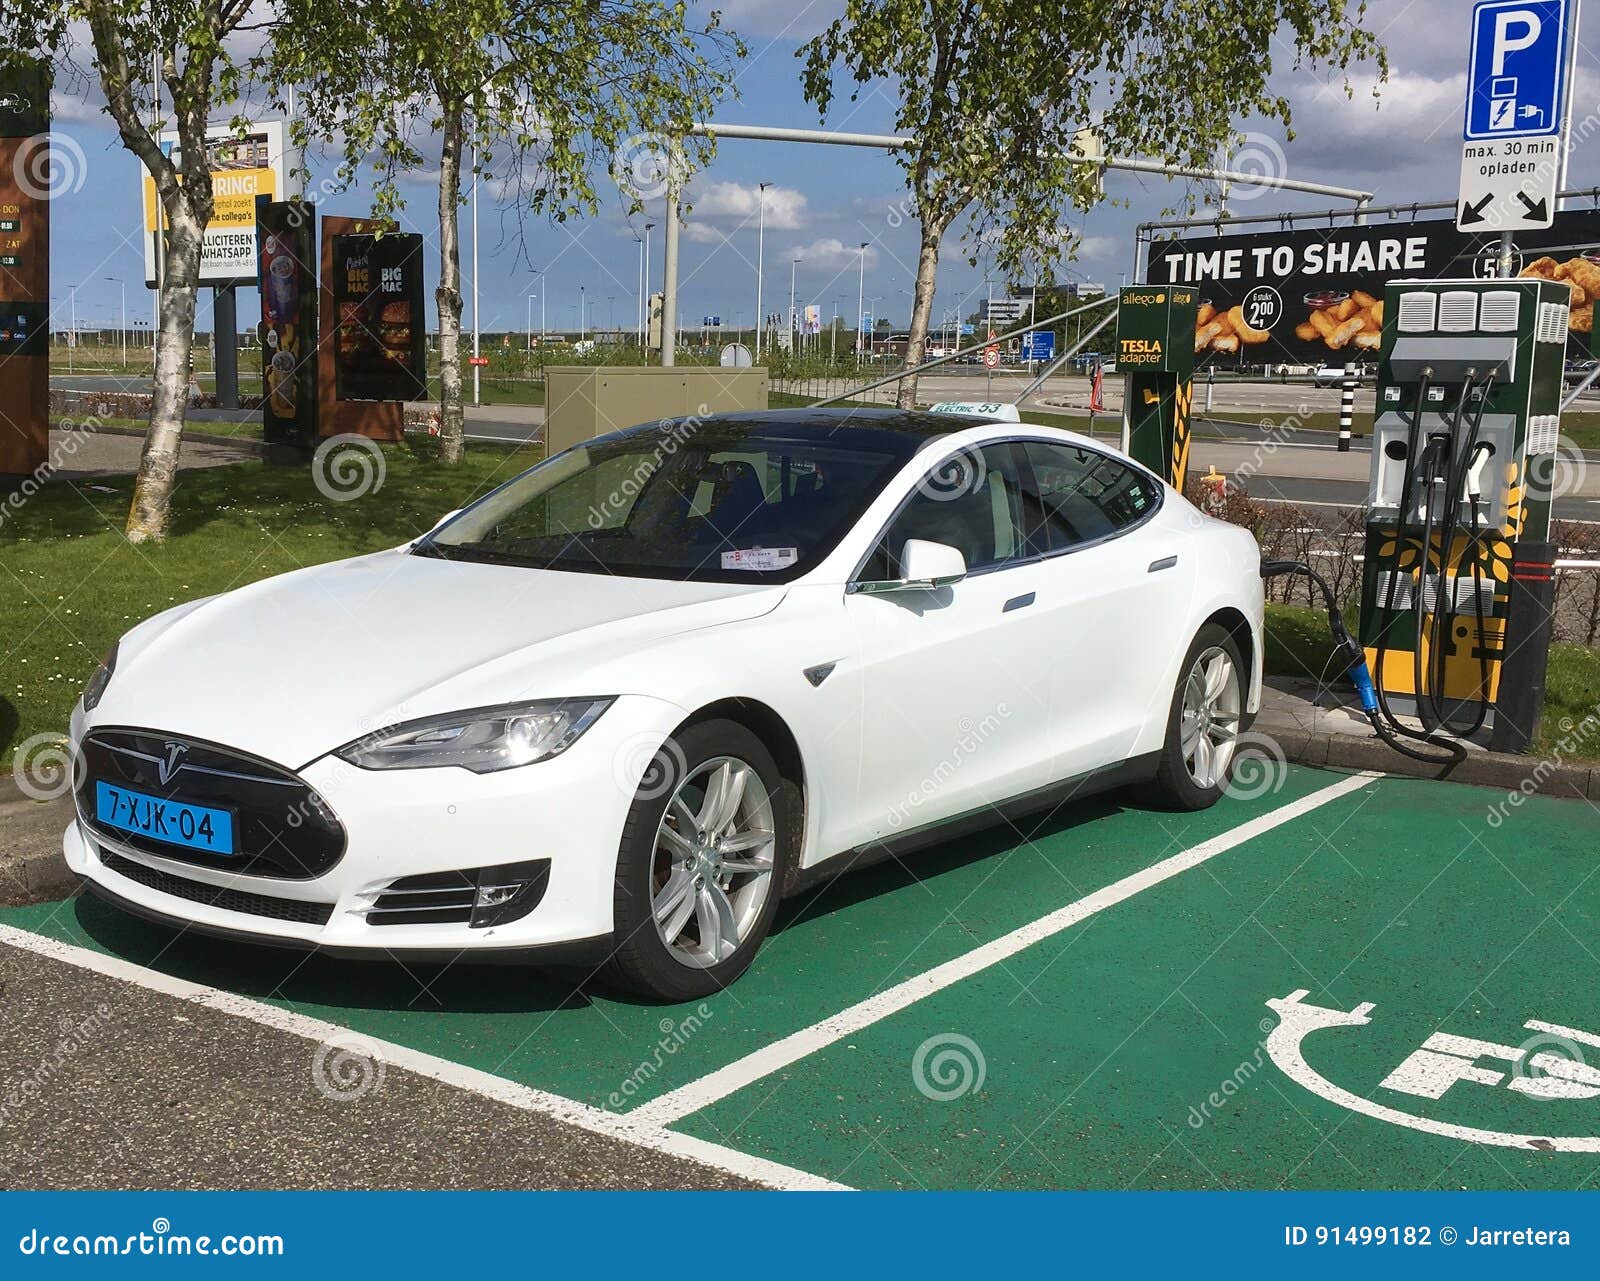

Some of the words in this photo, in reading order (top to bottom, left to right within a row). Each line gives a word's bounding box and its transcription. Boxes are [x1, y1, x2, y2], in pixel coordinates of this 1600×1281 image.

[1491, 10, 1541, 76] P
[1465, 146, 1497, 158] max.
[1504, 142, 1522, 156] 30
[1527, 141, 1554, 154] min
[1480, 161, 1536, 177] opladen
[211, 175, 257, 196] IRING!
[203, 234, 252, 246] LLICITEREN
[201, 247, 251, 259] WHATSAPP
[1165, 249, 1243, 283] TIME
[1252, 246, 1294, 277] TO
[1301, 237, 1427, 275] SHARE
[381, 267, 402, 281] BIG
[381, 281, 402, 293] MAC
[1123, 292, 1156, 307] allego
[1120, 340, 1162, 353] TESLA
[1120, 353, 1162, 366] adapter
[934, 405, 974, 413] ELECTRIC
[978, 403, 1002, 413] 53
[108, 789, 215, 845] 7-XJK-04
